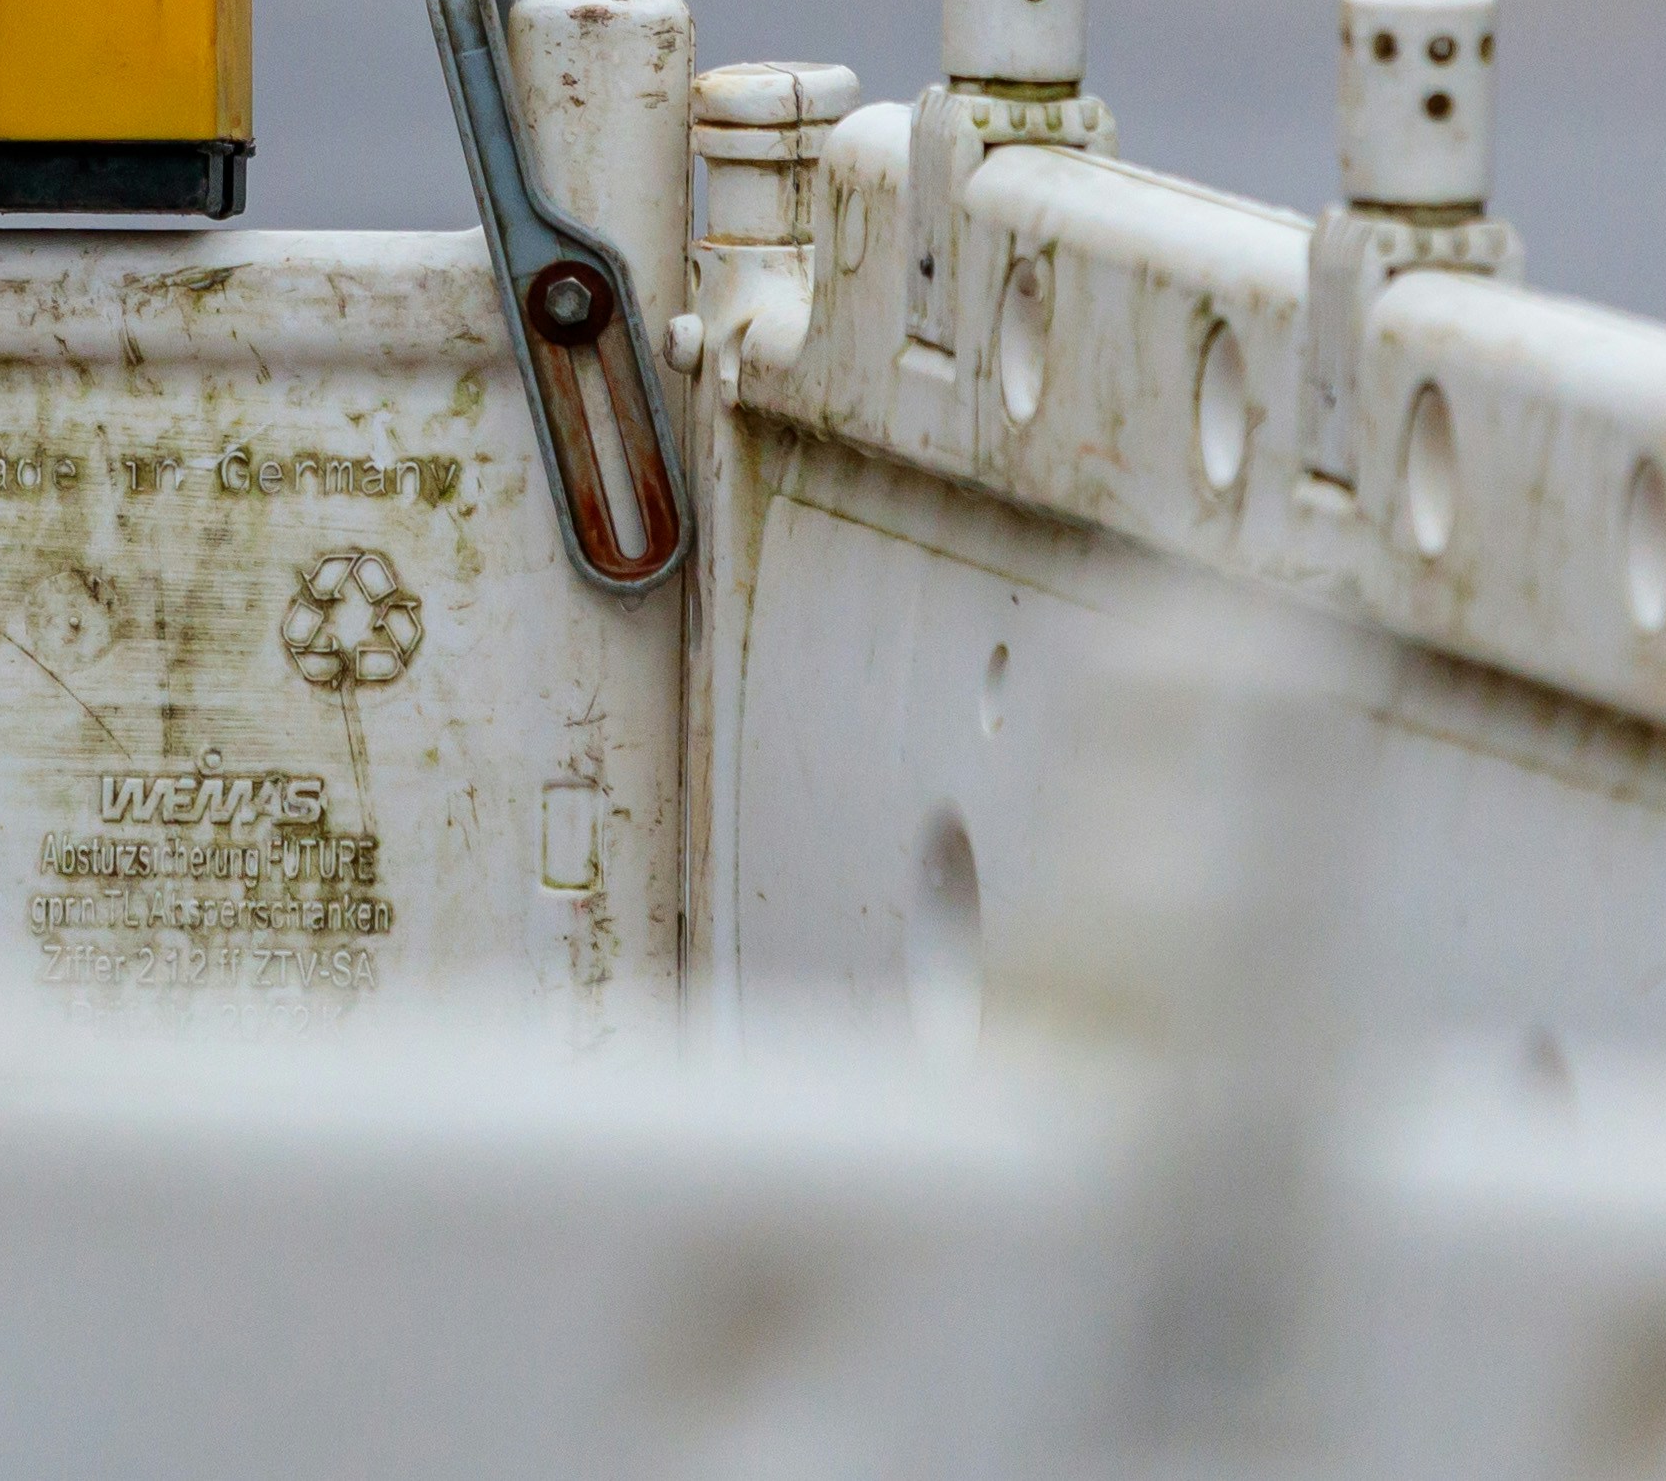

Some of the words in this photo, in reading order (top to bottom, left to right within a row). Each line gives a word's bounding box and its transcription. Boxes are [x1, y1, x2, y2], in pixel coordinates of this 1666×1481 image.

[124, 457, 182, 491] in
[220, 448, 460, 502] Germany
[102, 775, 326, 823] WEMAS
[40, 832, 260, 887] Absturzsicherung
[264, 835, 376, 883] FUTURE
[42, 943, 126, 984] Ziffer
[253, 947, 376, 989] ZTV-SA
